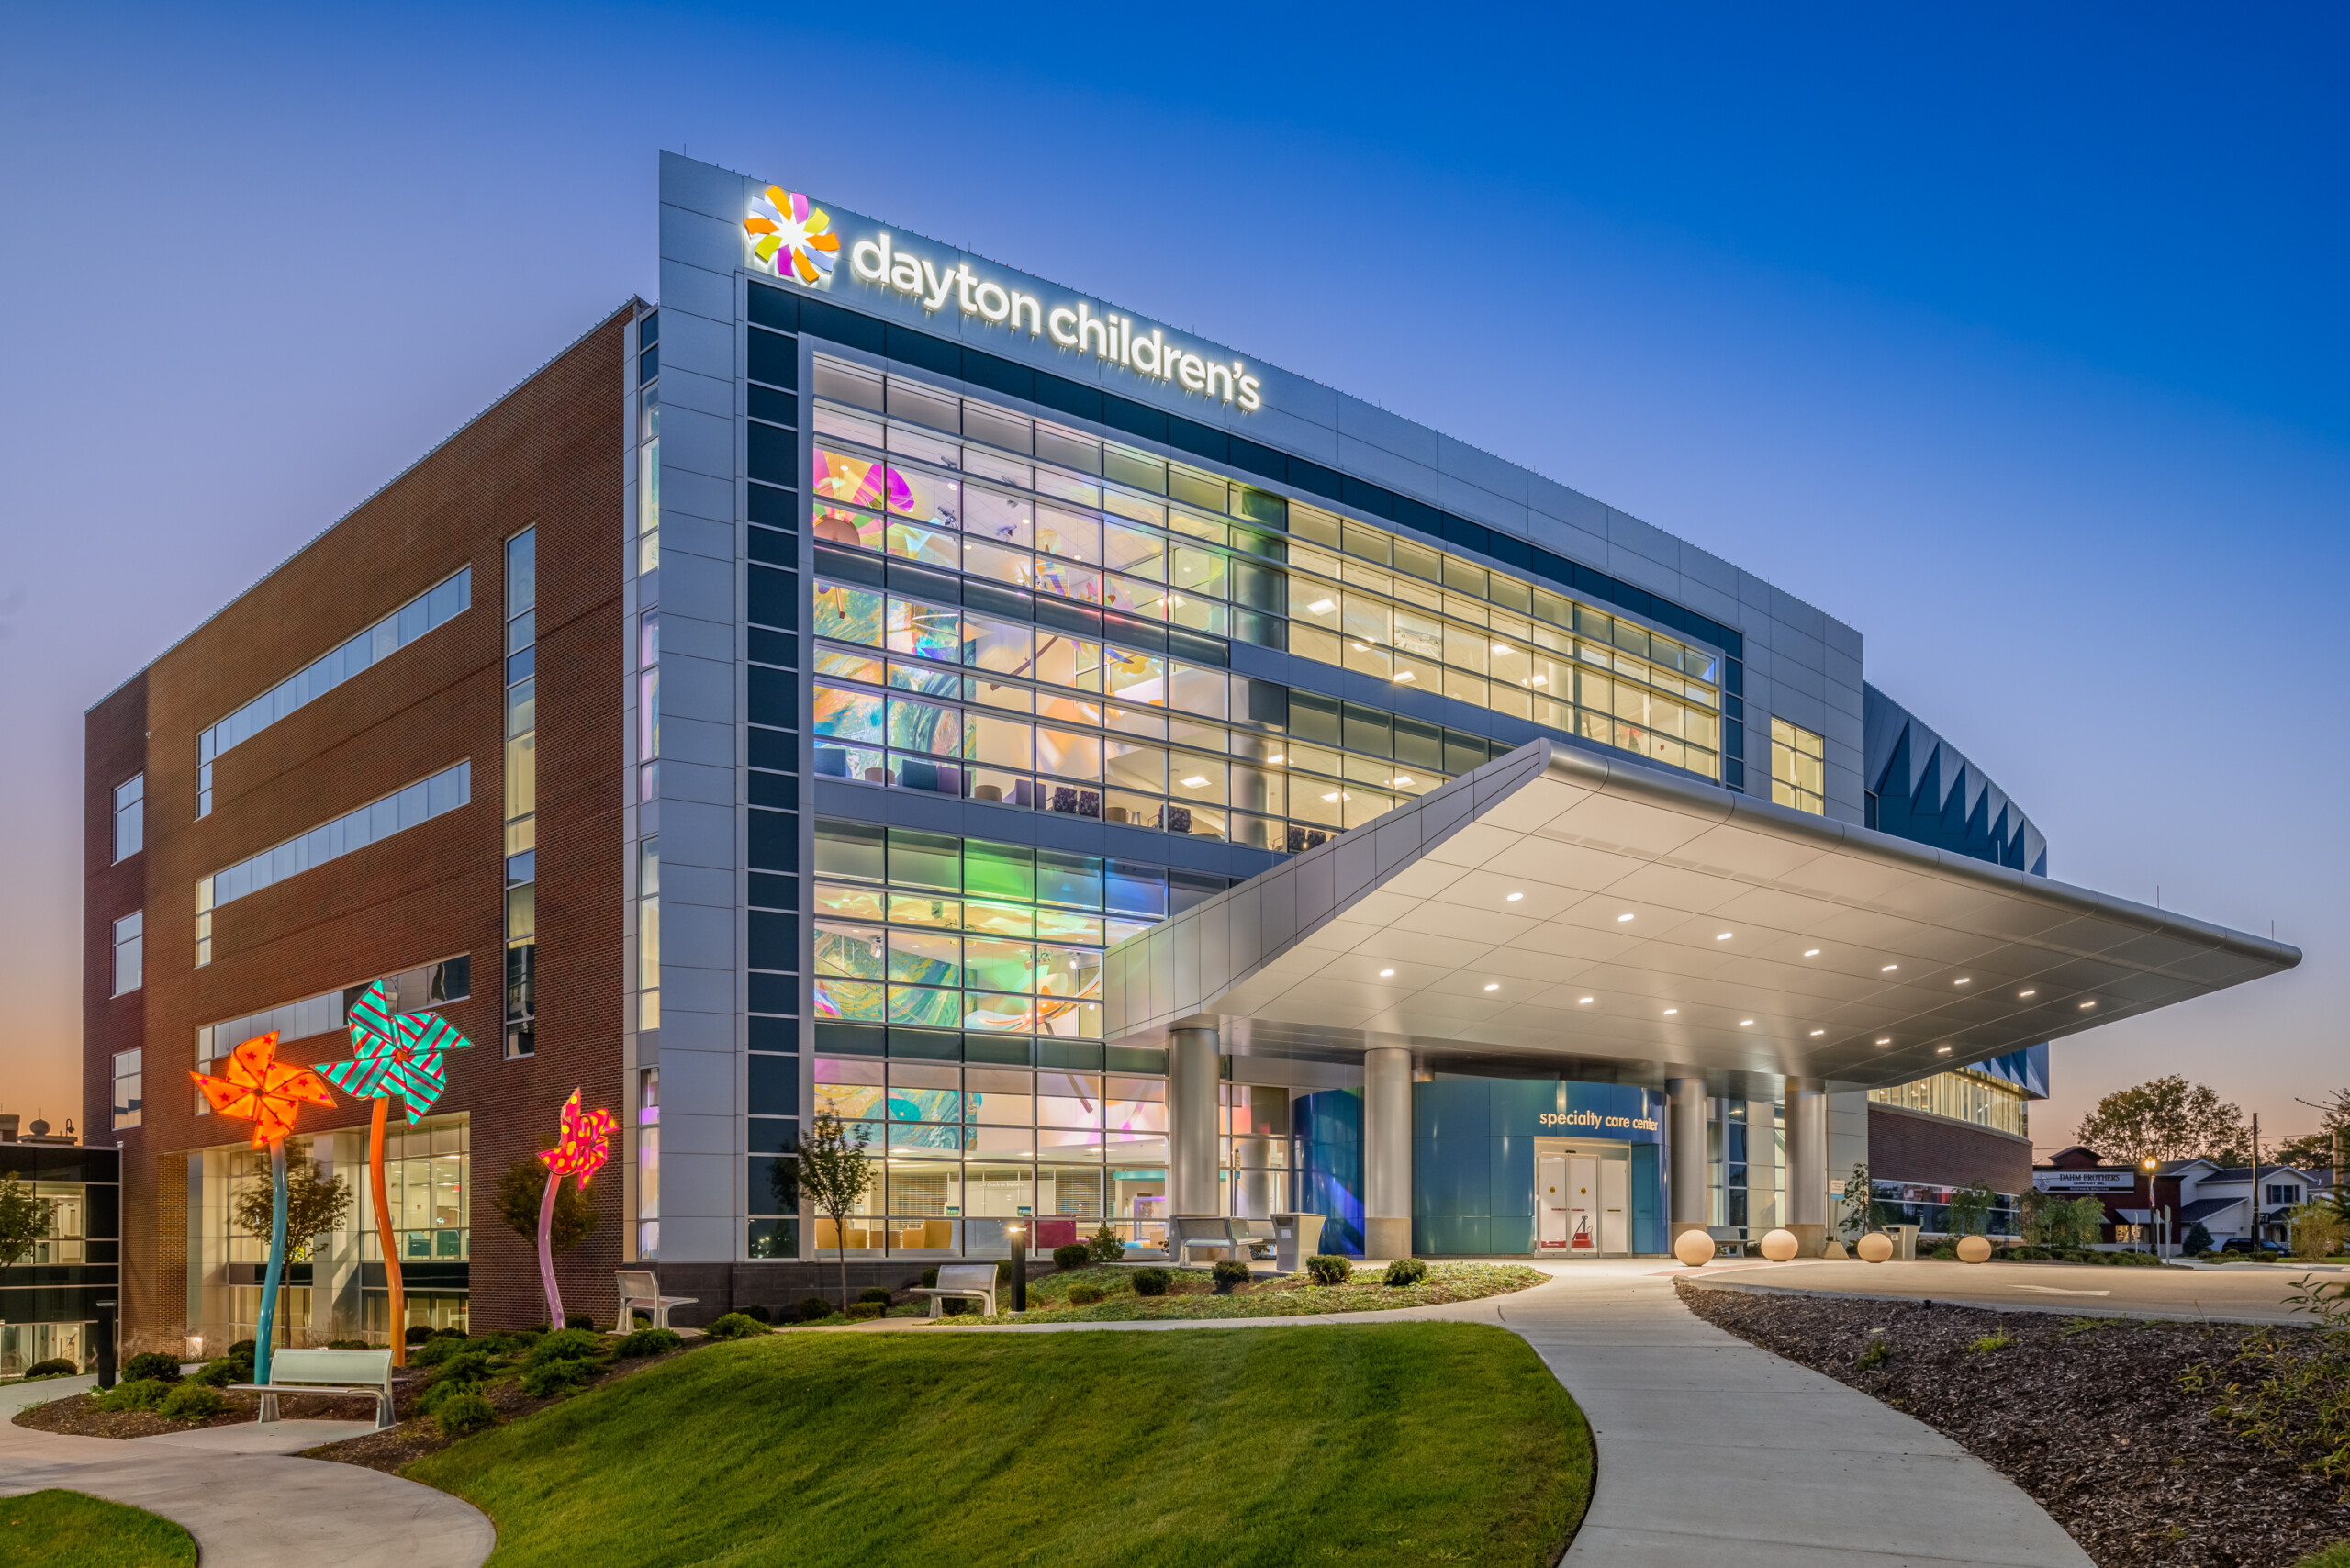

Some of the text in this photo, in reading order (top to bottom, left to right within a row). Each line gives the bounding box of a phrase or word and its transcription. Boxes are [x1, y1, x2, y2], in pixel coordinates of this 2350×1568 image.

[852, 234, 1261, 411] dayton children's
[1539, 1110, 1658, 1131] specialty care center
